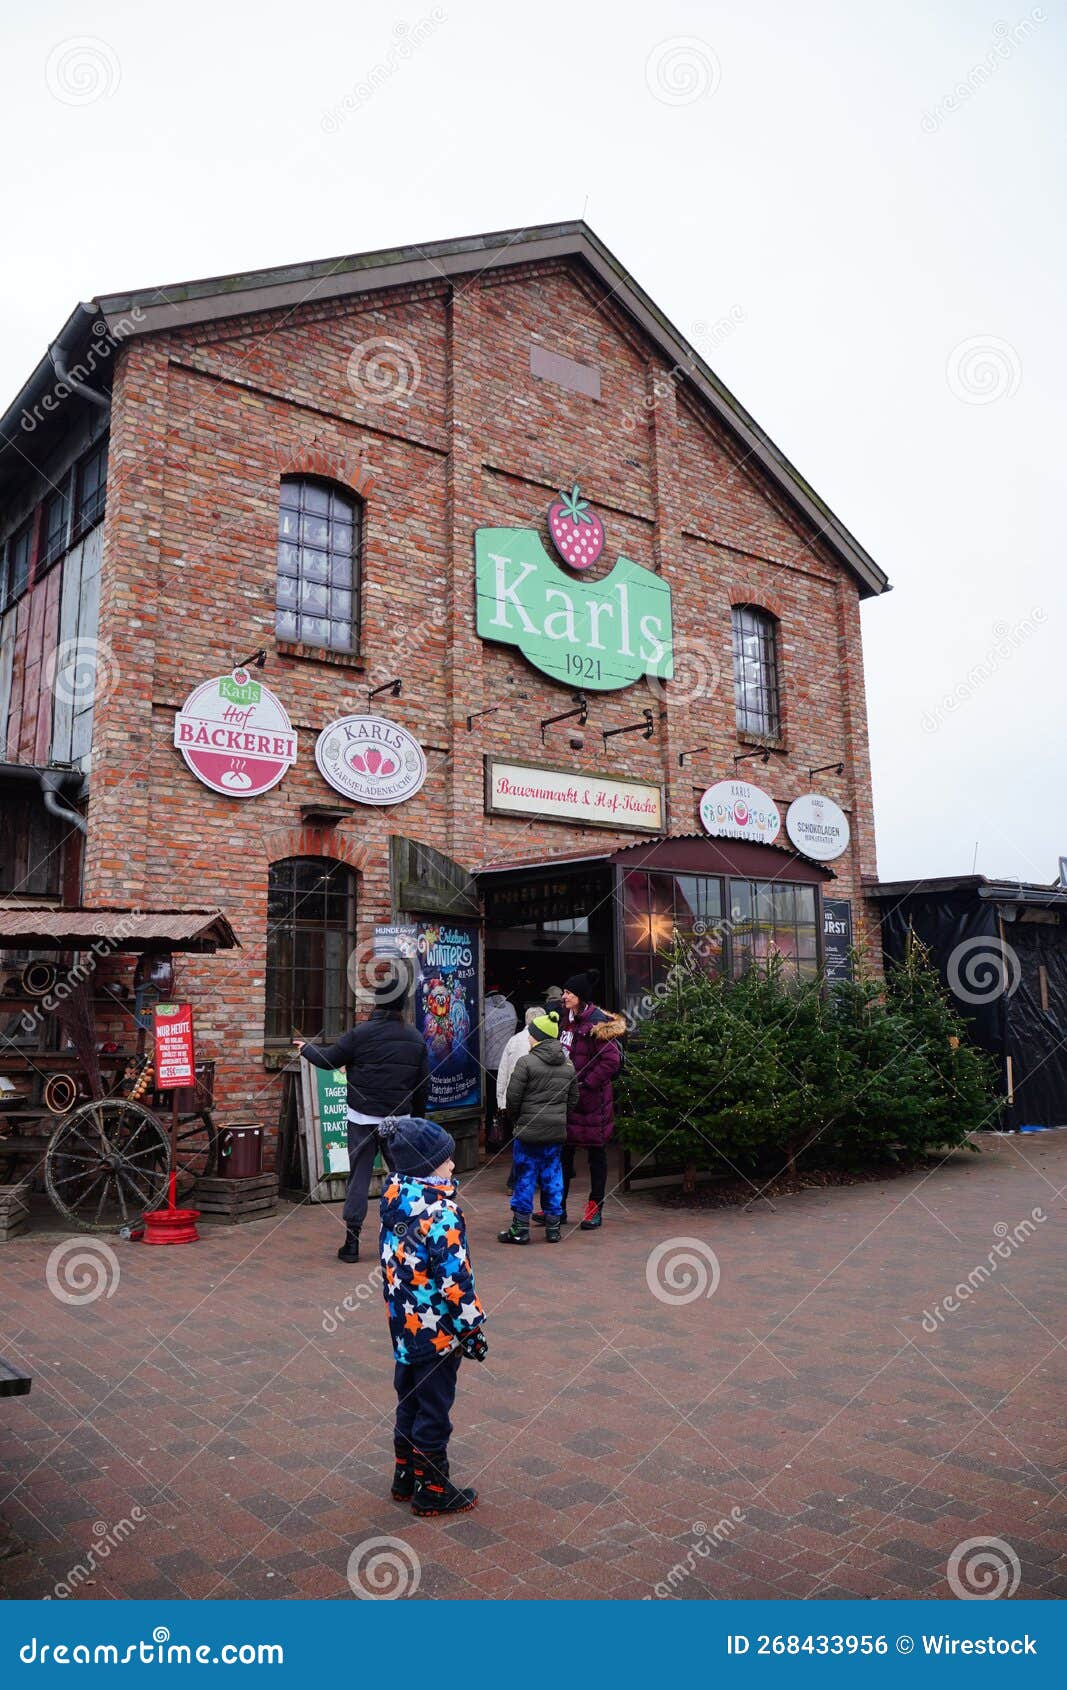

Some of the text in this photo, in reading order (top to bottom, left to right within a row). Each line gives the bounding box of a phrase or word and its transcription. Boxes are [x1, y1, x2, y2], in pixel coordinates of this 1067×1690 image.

[487, 552, 665, 664] Karls
[565, 653, 601, 681] 1921
[221, 683, 259, 701] Karls
[222, 704, 256, 729] Hof
[179, 722, 294, 757] BÄCKEREI
[343, 723, 404, 749] KARLS
[330, 761, 414, 796] MARMELADENKÜCHE
[496, 777, 578, 804] Bauernmarkt
[581, 790, 591, 805] &
[730, 785, 751, 798] KARLS
[797, 821, 840, 838] SCHOKOLADEN
[156, 1021, 191, 1037] NUR HEUTE
